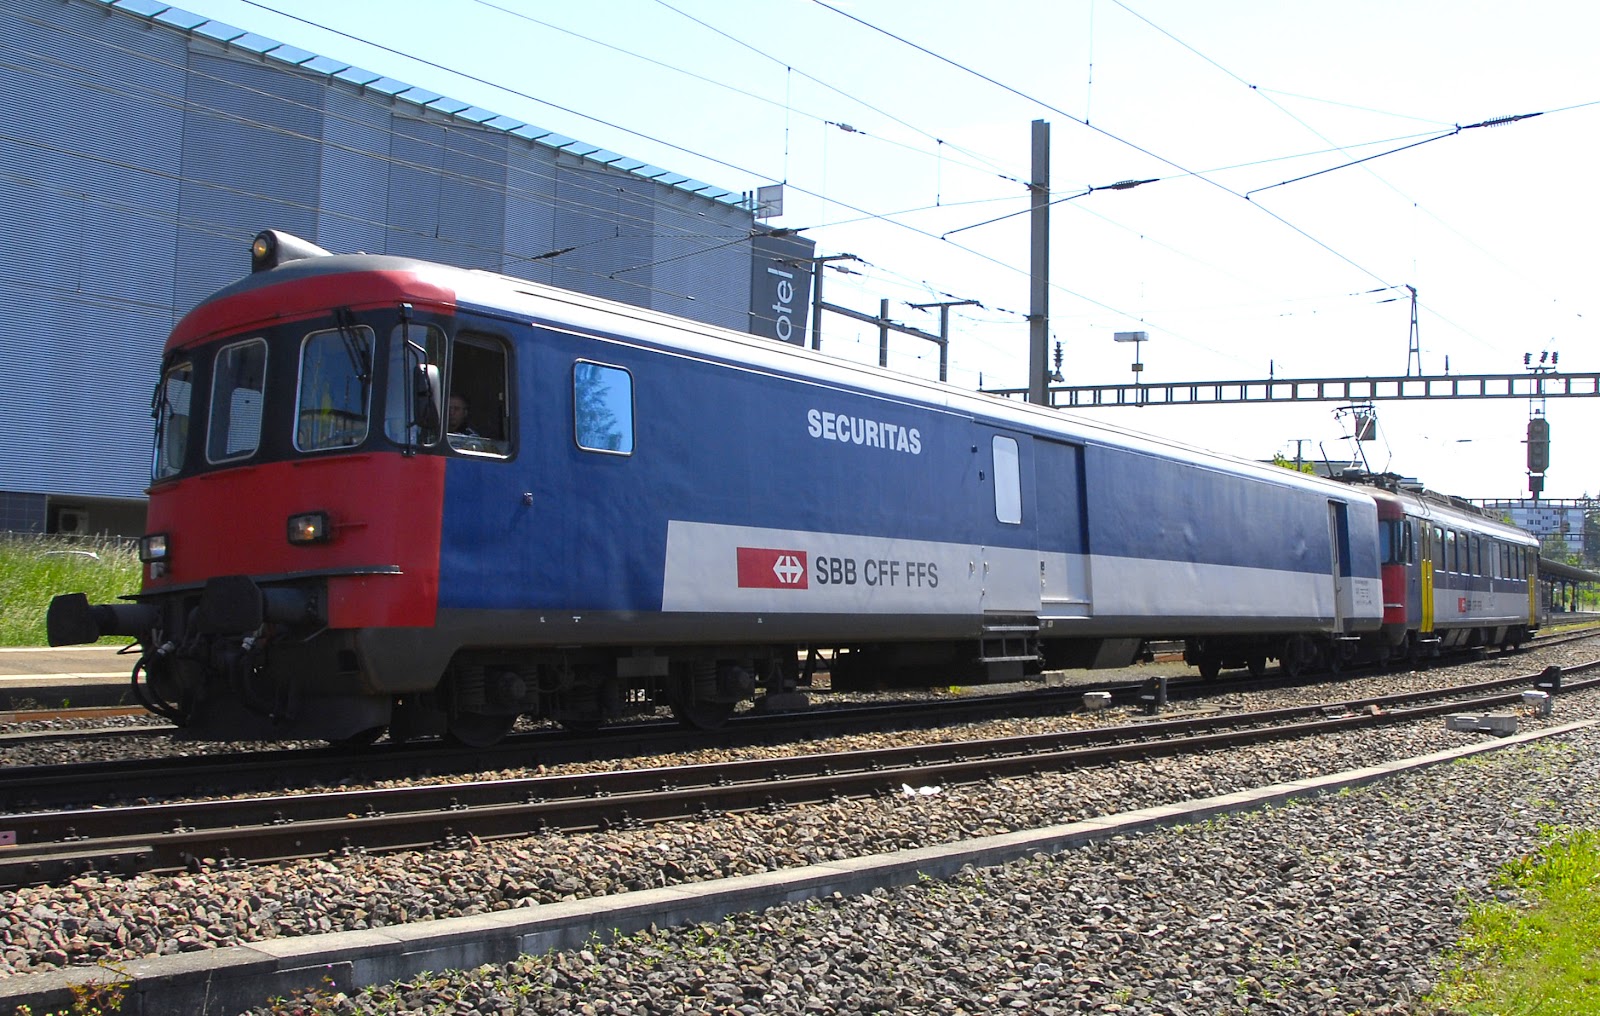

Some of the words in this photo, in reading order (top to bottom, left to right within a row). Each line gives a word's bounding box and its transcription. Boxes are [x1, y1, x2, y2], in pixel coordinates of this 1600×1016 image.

[767, 267, 793, 341] otel
[807, 408, 921, 454] SECURITAS
[816, 556, 857, 585] SBB
[864, 559, 900, 586] CFF
[906, 562, 939, 588] FFS
